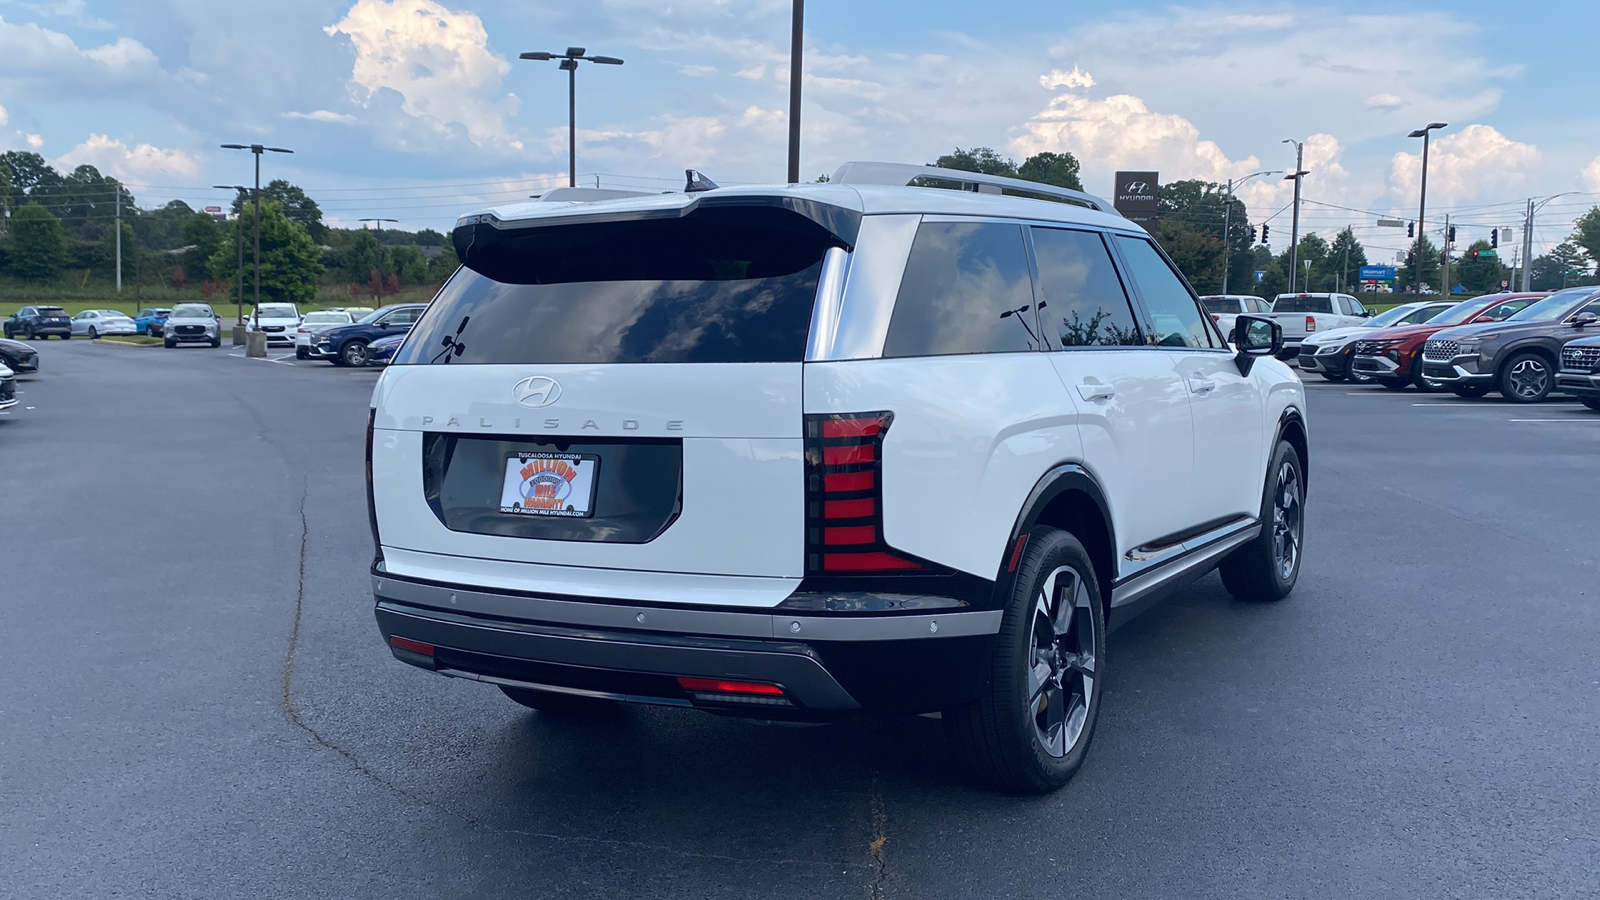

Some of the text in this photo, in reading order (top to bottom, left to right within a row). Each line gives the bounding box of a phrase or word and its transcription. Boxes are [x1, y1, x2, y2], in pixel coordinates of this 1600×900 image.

[422, 415, 684, 431] PALISADE
[520, 459, 577, 483] MILLION
[535, 485, 557, 498] MILE
[524, 497, 565, 509] WARRANTY
